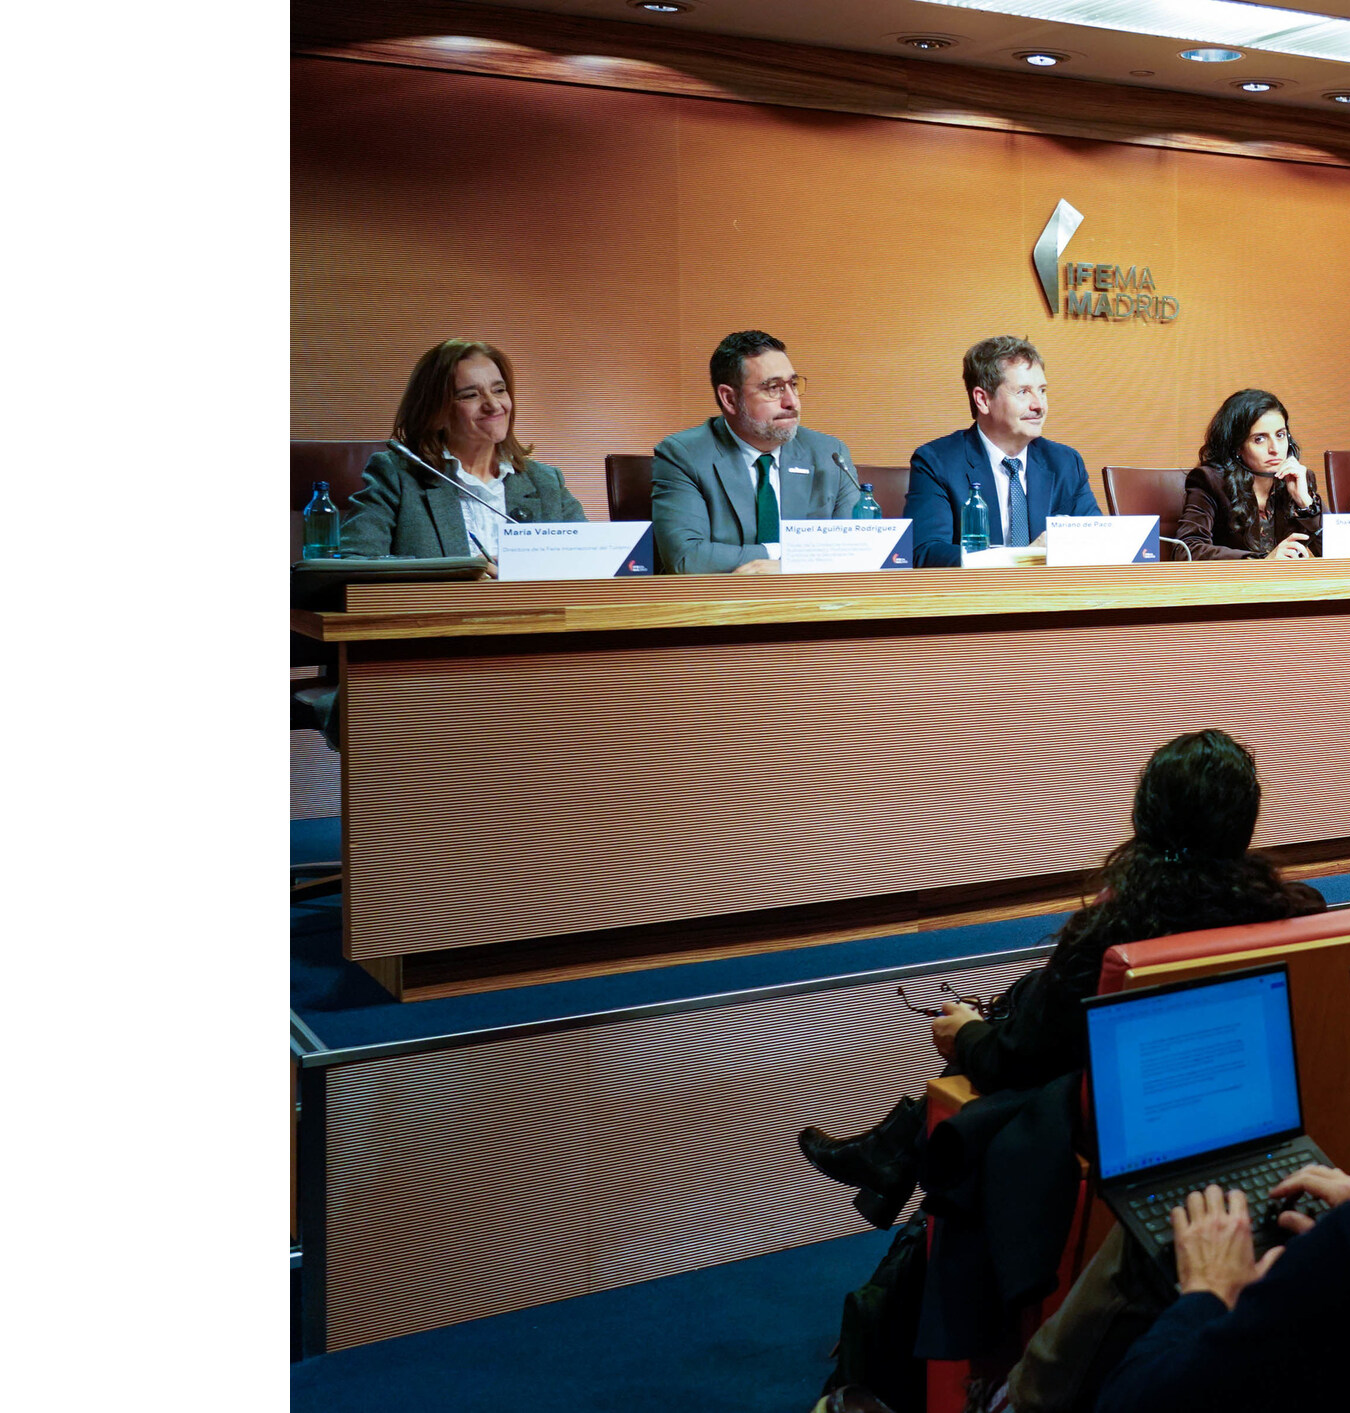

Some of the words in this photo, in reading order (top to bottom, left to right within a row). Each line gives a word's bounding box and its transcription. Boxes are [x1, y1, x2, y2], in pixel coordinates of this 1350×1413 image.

[1066, 262, 1156, 290] IFEMA
[1067, 289, 1180, 320] MADRID
[535, 528, 579, 536] Valcarce
[785, 526, 814, 534] Miguel
